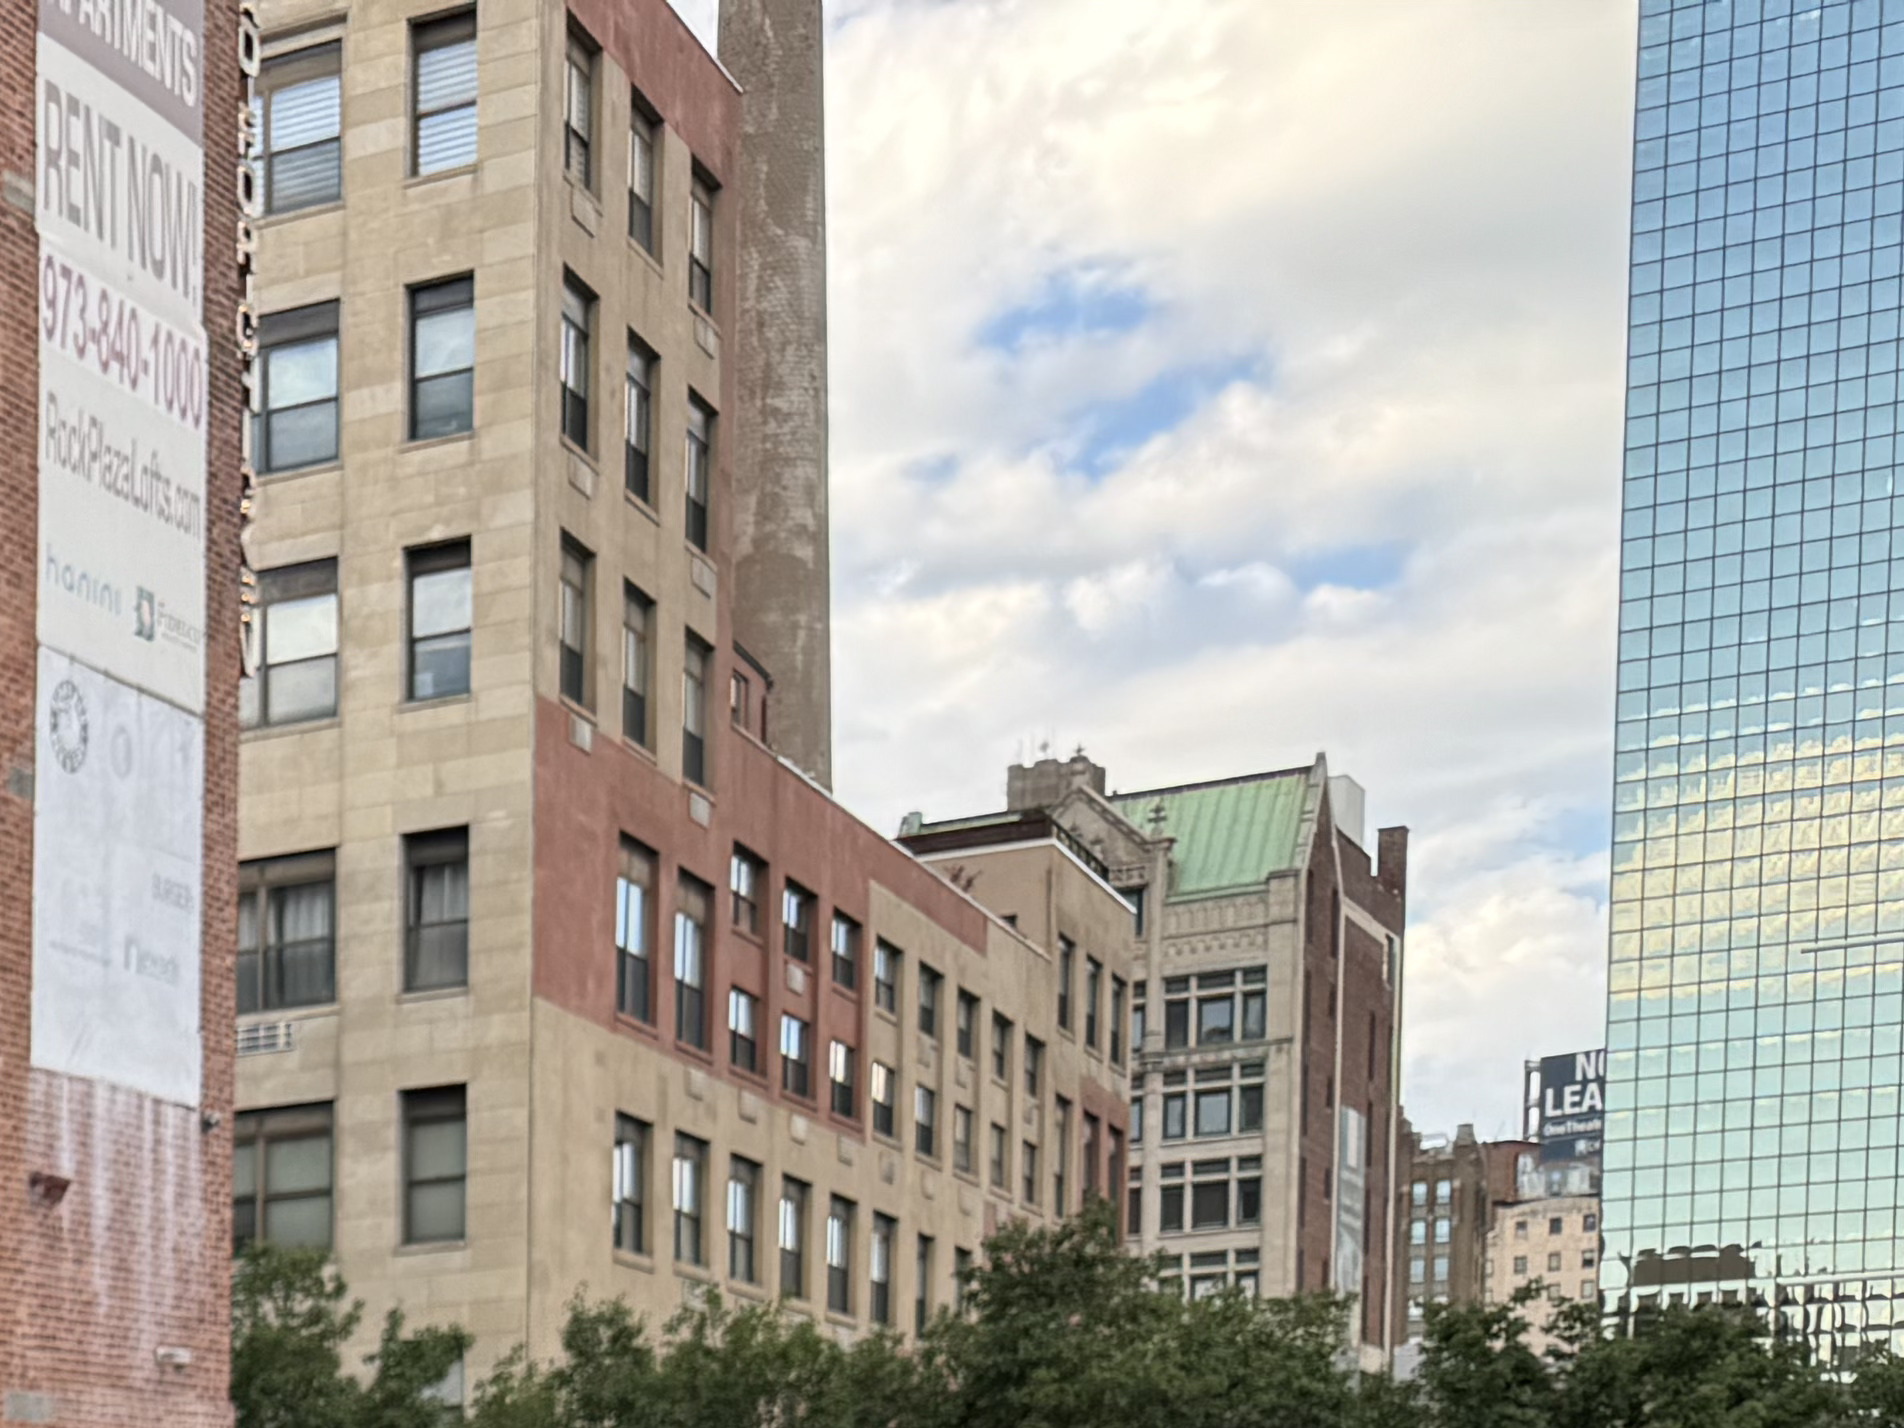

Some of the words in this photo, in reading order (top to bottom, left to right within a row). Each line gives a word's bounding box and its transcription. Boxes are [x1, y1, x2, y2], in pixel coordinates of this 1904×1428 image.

[49, 0, 198, 107] RTMENTS
[43, 79, 121, 250] RENT
[127, 135, 199, 304] NOW!
[42, 255, 204, 431] 973-840-1000
[45, 390, 202, 543] RockPlazaLofts.com
